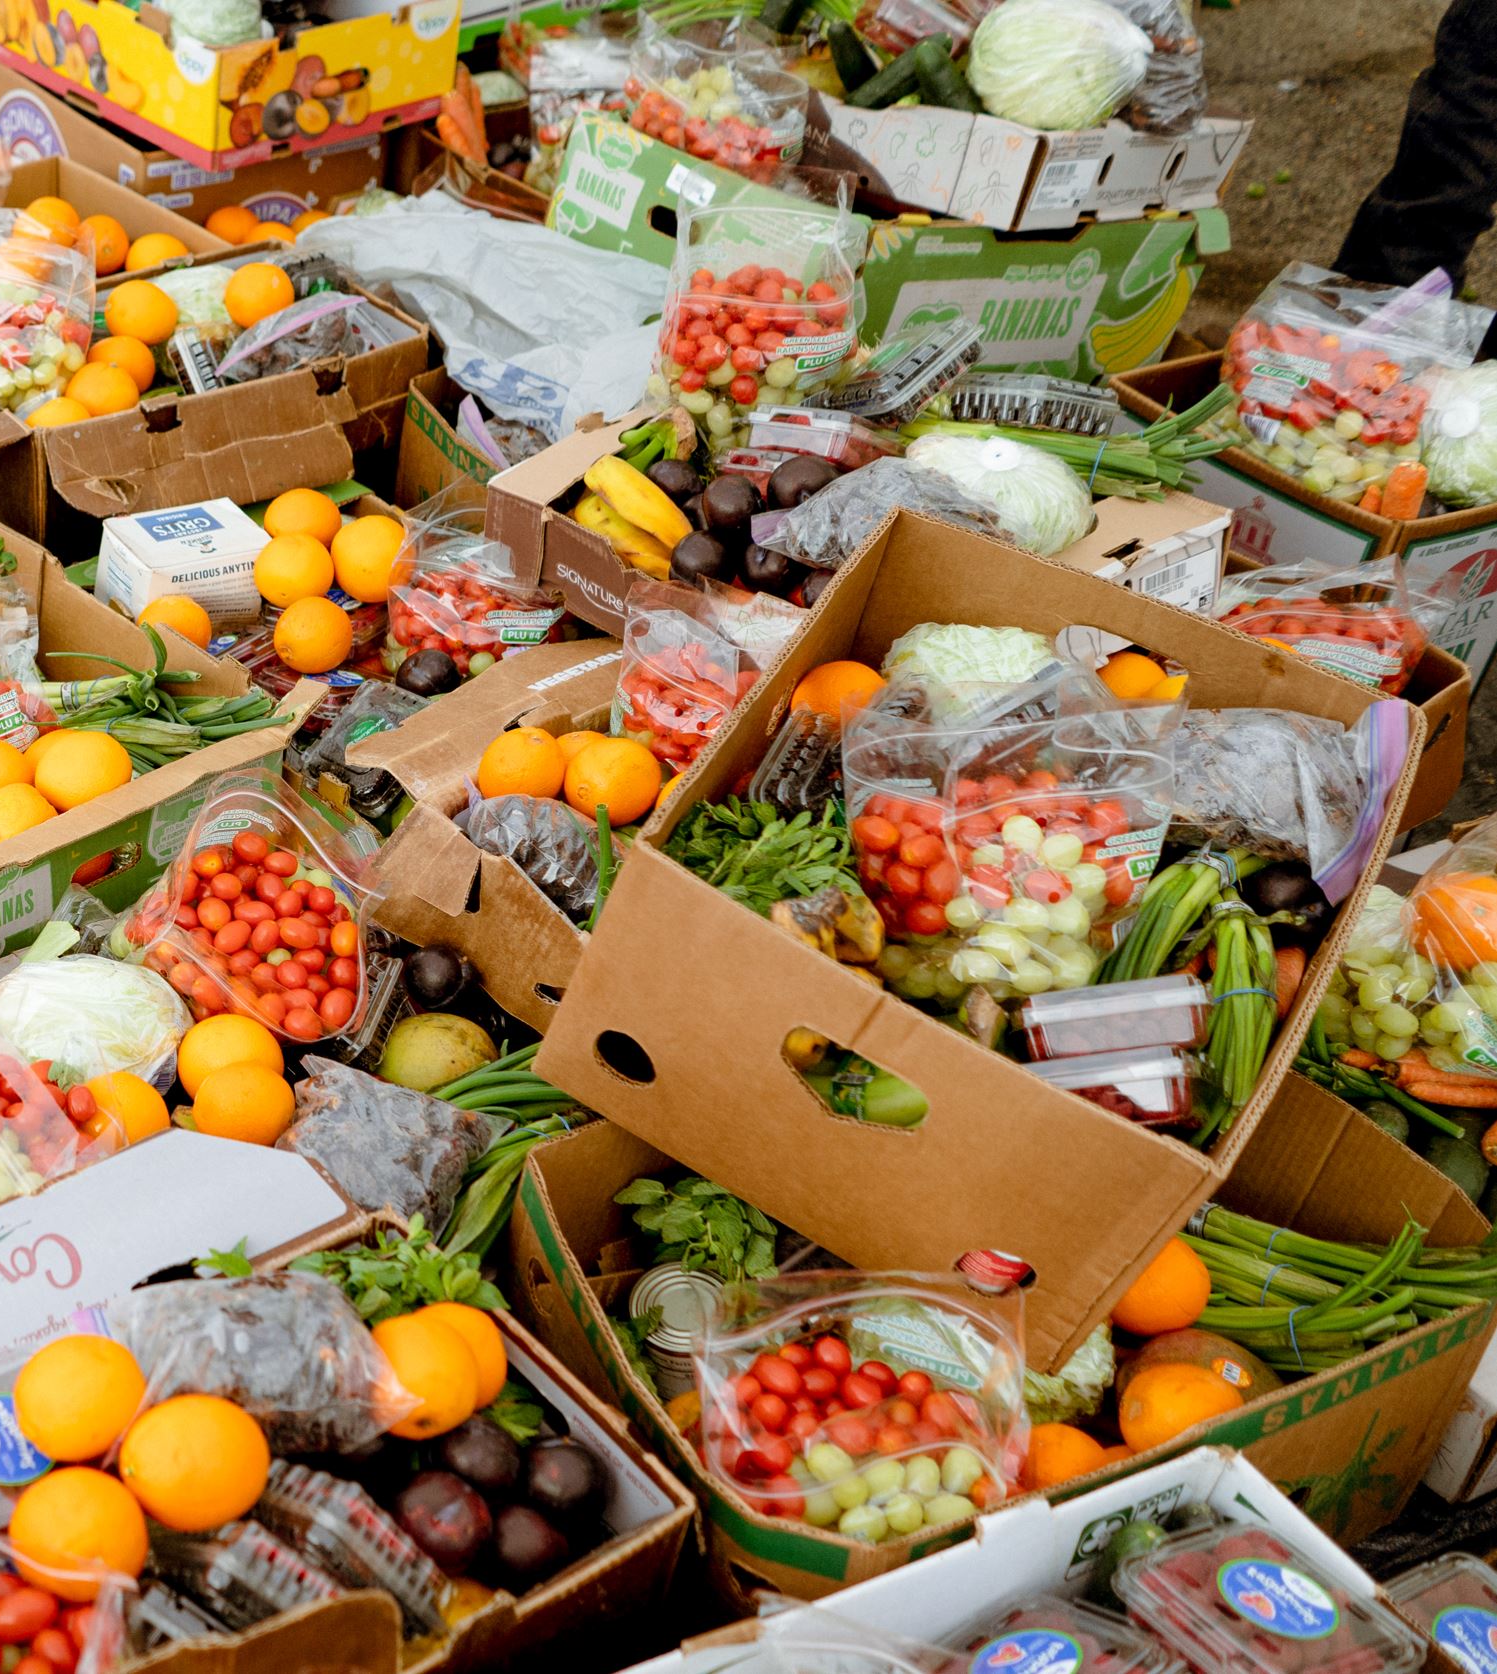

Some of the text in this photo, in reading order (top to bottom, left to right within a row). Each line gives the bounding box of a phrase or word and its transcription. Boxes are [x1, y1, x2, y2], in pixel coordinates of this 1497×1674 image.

[576, 167, 626, 211] BANANAS
[978, 296, 1082, 342] BANANAS
[803, 356, 824, 368] PLU
[409, 400, 489, 482] ANANAS
[152, 517, 212, 537] GRITS
[171, 567, 220, 584] DELICIOUS
[507, 631, 527, 640] PLU
[1261, 1312, 1484, 1433] BANANAS
